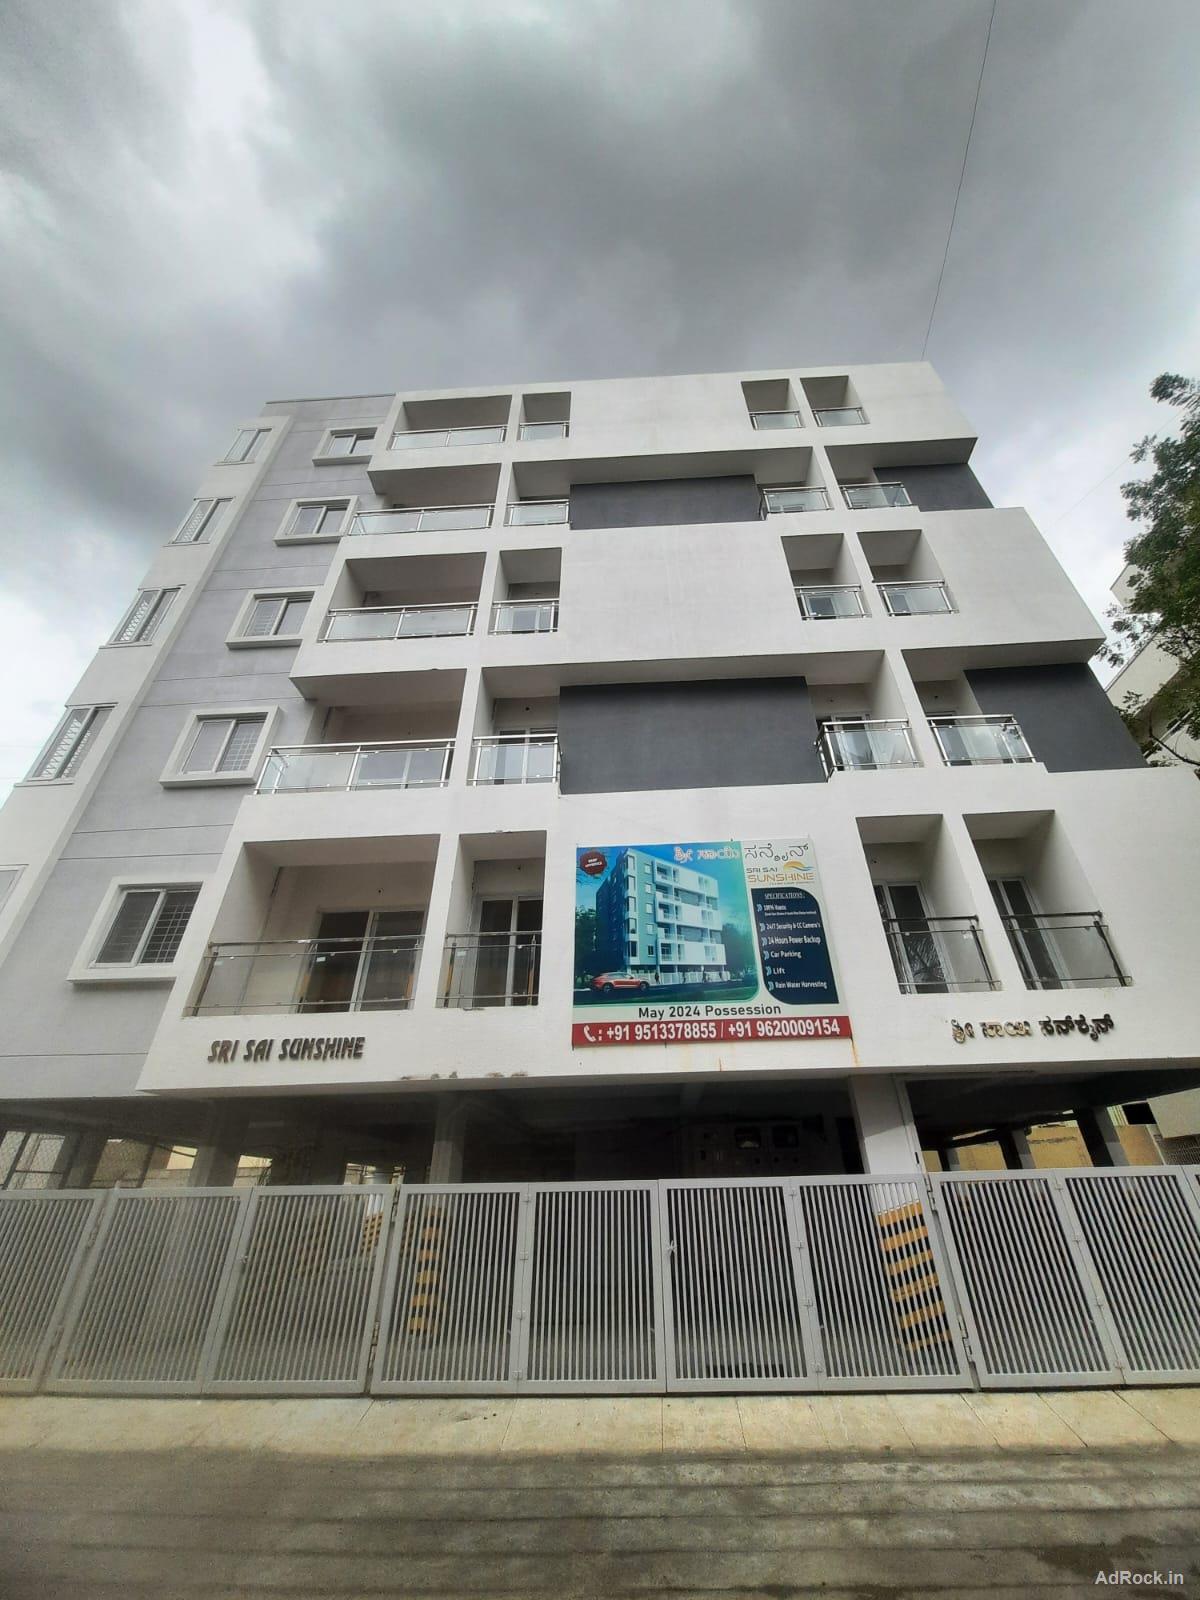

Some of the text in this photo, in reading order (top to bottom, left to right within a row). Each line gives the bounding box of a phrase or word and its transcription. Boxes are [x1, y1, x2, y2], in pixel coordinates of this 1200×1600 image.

[748, 872, 815, 883] SUNSHINE
[776, 922, 792, 930] Security
[768, 937, 774, 945] 24
[774, 936, 788, 944] Hours
[803, 936, 821, 944] Backup
[638, 1004, 781, 1020] May 2024 Possession
[607, 1024, 630, 1040] +91
[635, 1022, 717, 1040] 9513378855
[728, 1021, 752, 1038] +91
[756, 1018, 840, 1036] 9620009154
[208, 1036, 366, 1063] SRI SAI SUNSHINE
